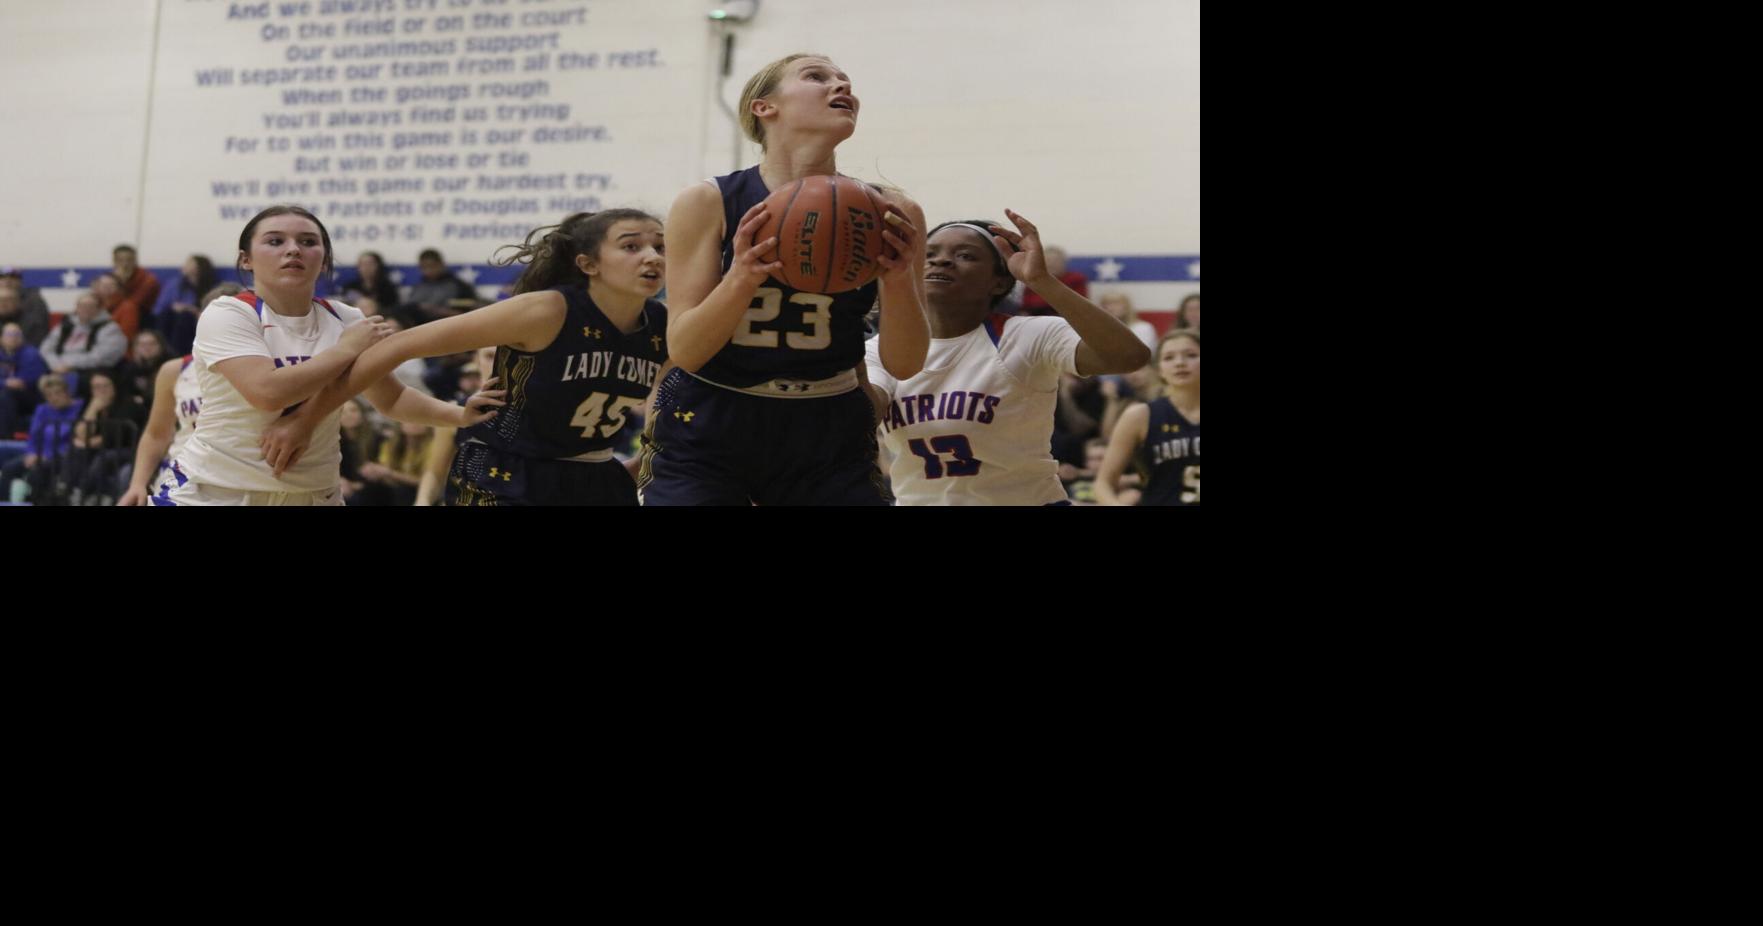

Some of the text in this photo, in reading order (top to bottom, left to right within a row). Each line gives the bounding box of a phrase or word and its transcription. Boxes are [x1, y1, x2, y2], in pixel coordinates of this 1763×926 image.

[228, 2, 270, 20] And
[278, 1, 310, 17] we
[260, 7, 588, 41] On the field or on the court
[286, 32, 560, 62] Our unanimous support
[196, 68, 234, 87] Will
[240, 64, 336, 86] separate
[345, 62, 383, 81] our
[391, 59, 449, 79] team
[457, 55, 515, 76] from
[523, 53, 549, 72] all
[558, 51, 599, 70] the
[282, 78, 549, 105] When the goings rough
[264, 102, 570, 130] You'll always find us trying
[225, 136, 258, 153] For
[268, 134, 290, 152] to
[297, 133, 336, 151] win
[343, 131, 383, 150] this
[393, 130, 451, 150] game
[461, 127, 478, 145] is
[485, 129, 523, 144] our
[294, 150, 529, 173] But win or lose or tie
[210, 179, 260, 197] We'll
[266, 178, 309, 198] give
[318, 176, 358, 195] this
[366, 176, 424, 195] game
[432, 174, 470, 193] our
[477, 172, 566, 191] hardest
[328, 200, 415, 218] Patriots
[421, 198, 444, 215] of
[452, 196, 538, 216] Douglas
[550, 195, 601, 213] High
[800, 211, 819, 277] ELITE
[731, 287, 834, 350] 23
[561, 351, 613, 382] LADY
[569, 391, 647, 439] 45
[882, 390, 1001, 434] PATRIOTS
[907, 433, 983, 480] 13
